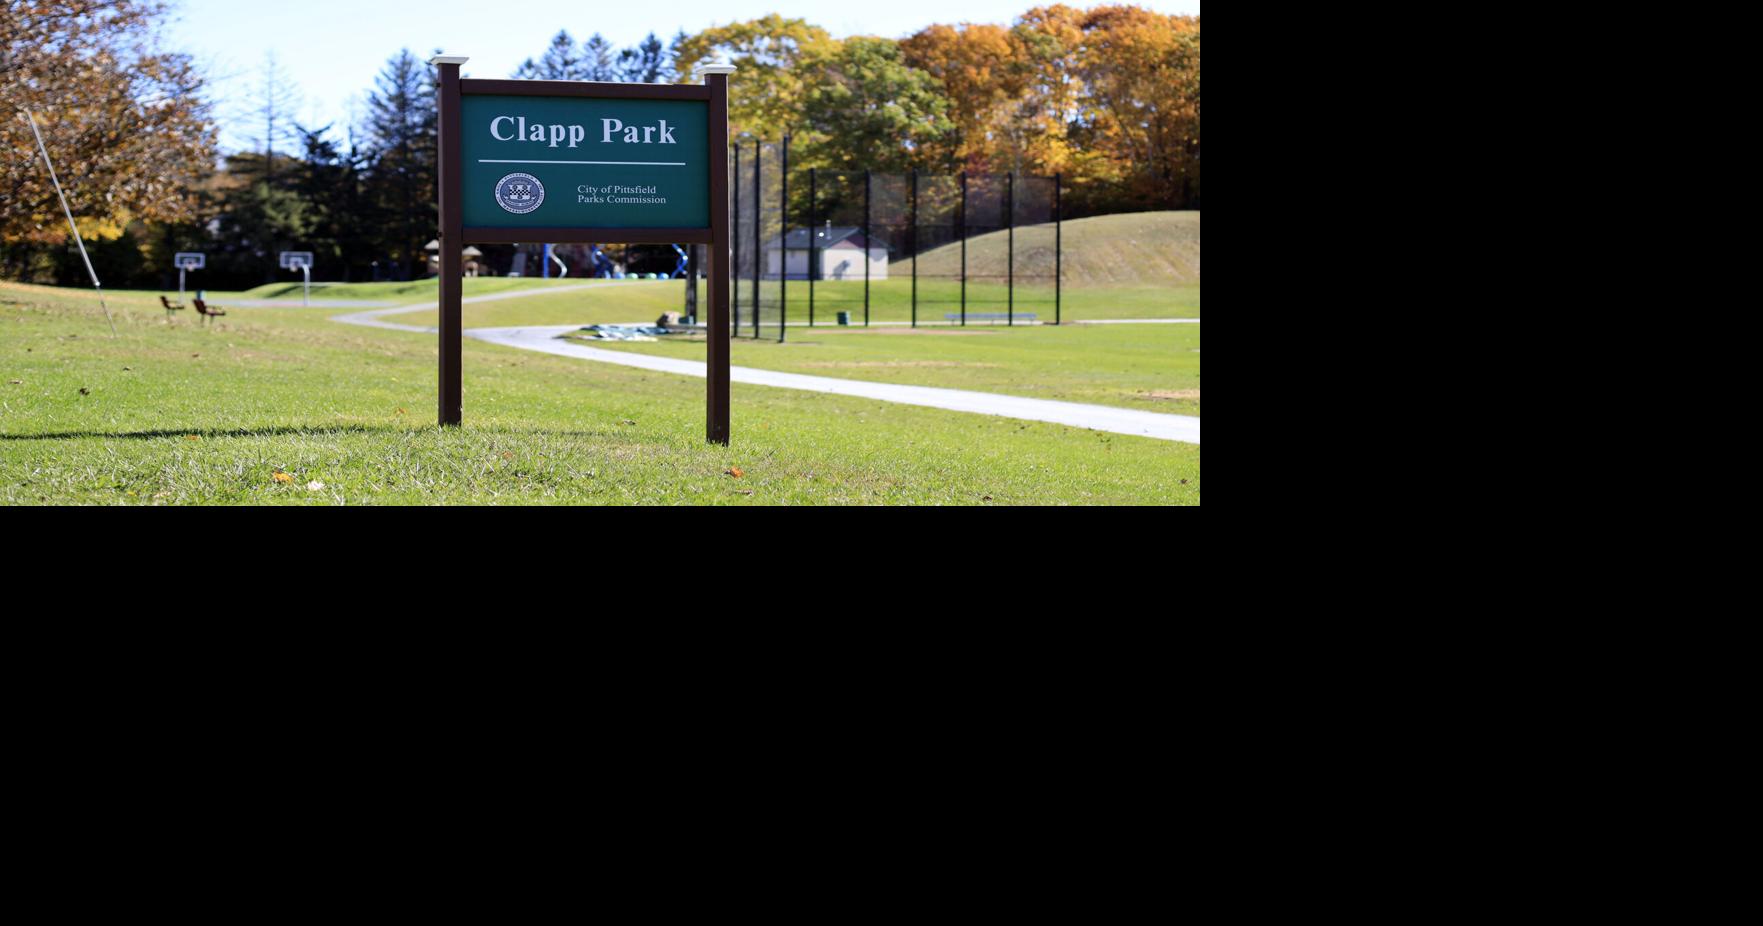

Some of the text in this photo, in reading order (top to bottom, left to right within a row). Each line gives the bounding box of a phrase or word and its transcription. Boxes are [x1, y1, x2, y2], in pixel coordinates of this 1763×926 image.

[490, 116, 677, 147] Clapp Park
[577, 185, 656, 195] City of Pittsfield
[578, 195, 666, 204] Parks Commission
